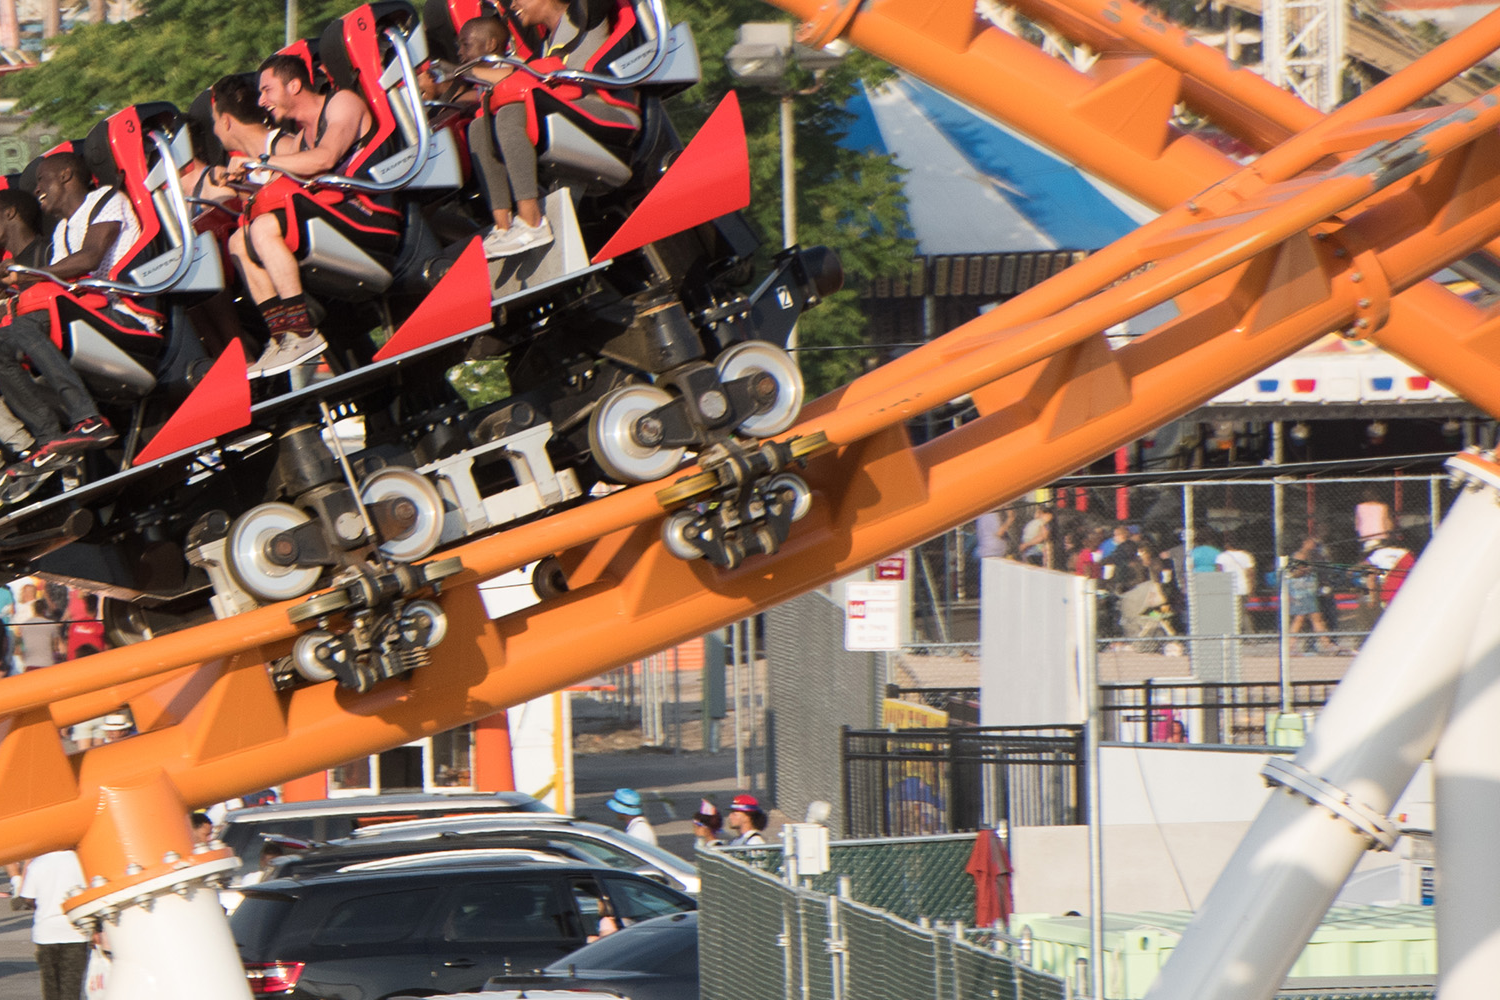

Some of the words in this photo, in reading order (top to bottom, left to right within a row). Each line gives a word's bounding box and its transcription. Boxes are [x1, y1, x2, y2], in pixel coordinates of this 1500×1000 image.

[357, 17, 368, 31] 6
[125, 119, 136, 134] 3
[779, 287, 791, 306] 2
